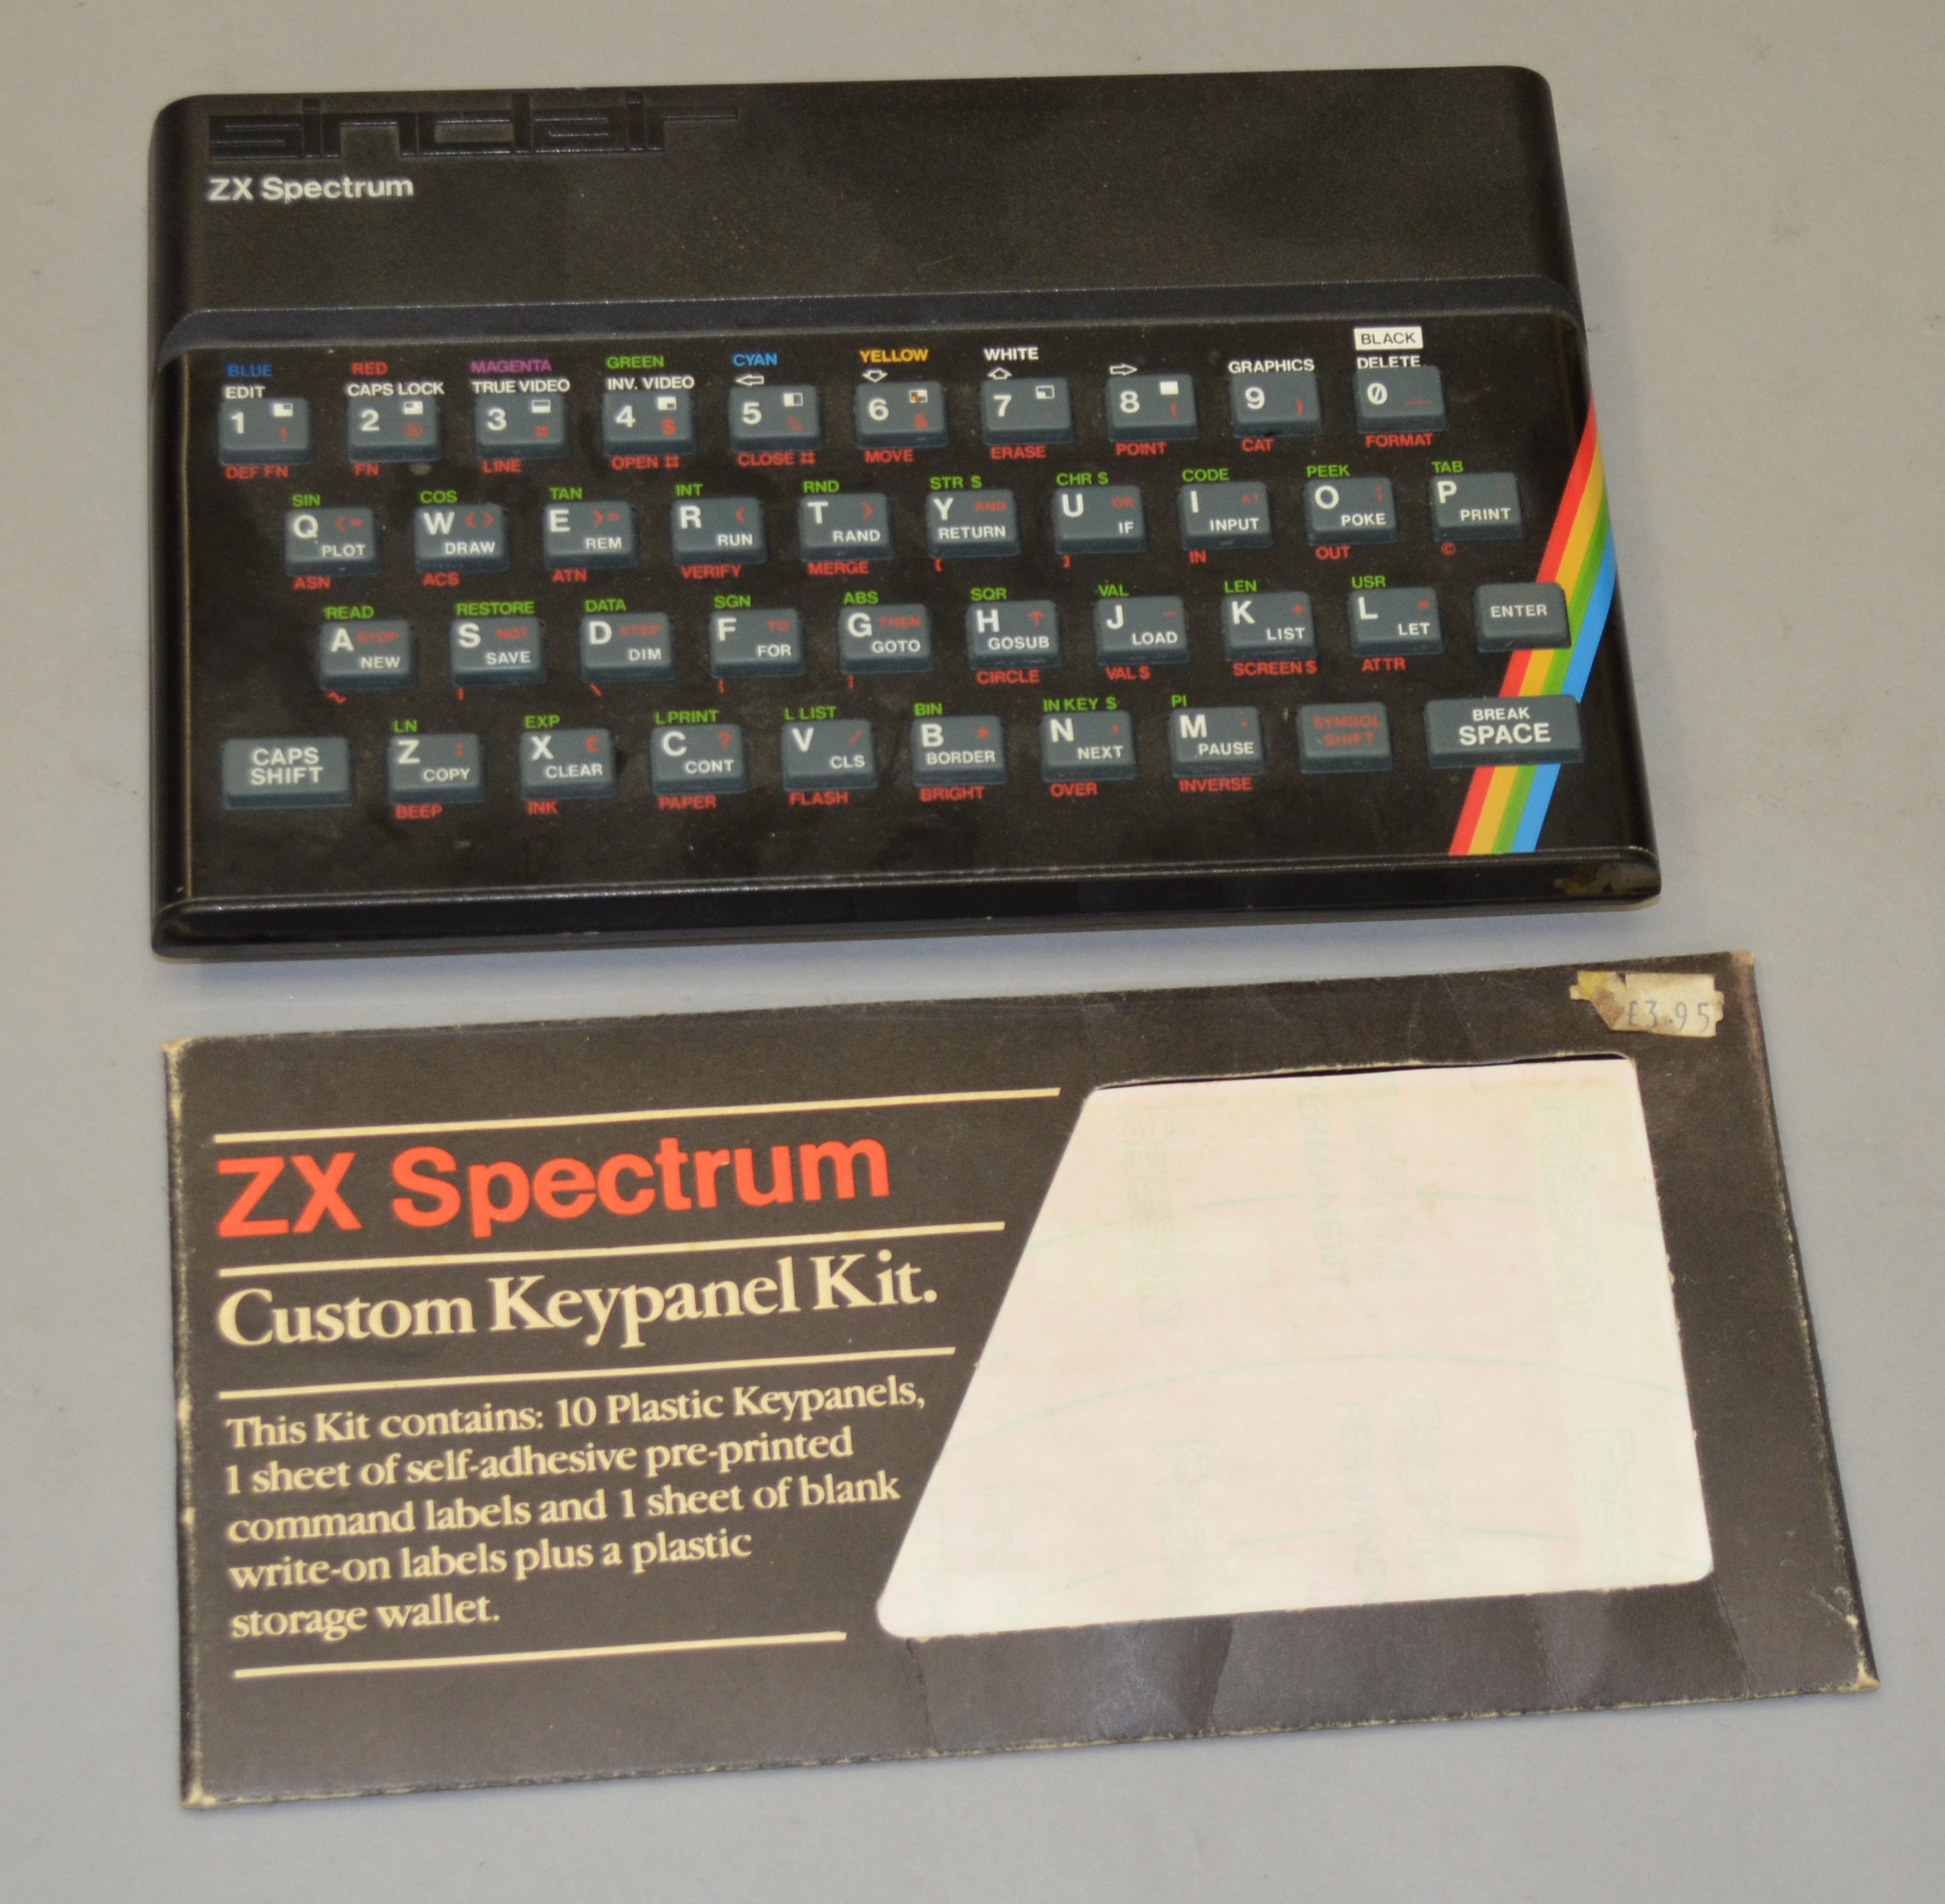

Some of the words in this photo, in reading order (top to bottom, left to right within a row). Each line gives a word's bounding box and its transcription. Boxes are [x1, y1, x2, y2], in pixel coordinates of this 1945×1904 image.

[209, 178, 252, 200] ZX
[262, 176, 413, 202] Spectrum
[1360, 332, 1416, 345] BLACK
[733, 352, 778, 367] CYAN
[860, 348, 929, 363] YELLOW
[984, 347, 1039, 361] WHITE
[351, 361, 389, 375] RED
[470, 358, 551, 373] MAGENTA
[605, 355, 665, 370] GREEN
[1228, 358, 1315, 374] GRAPHICS
[1357, 355, 1420, 370] DELETE
[226, 364, 272, 377] BLUE
[347, 383, 394, 397] CAPS
[398, 382, 444, 396] LOCK
[472, 380, 516, 393] TRUE
[519, 379, 571, 393] VIDEO
[642, 376, 695, 389] VIDEO
[225, 386, 264, 399] EDIT
[1245, 386, 1265, 410] 9
[993, 394, 1012, 417] 7
[1120, 390, 1140, 413] 8
[615, 405, 636, 427] 4
[743, 402, 762, 425] 5
[868, 398, 889, 421] 6
[361, 409, 379, 432] 2
[487, 408, 506, 431] 3
[1241, 438, 1273, 453] CAT
[1365, 432, 1433, 448] FORMAT
[865, 448, 913, 463] MOVE
[990, 445, 1046, 460] ERASE
[1116, 441, 1166, 456] POINT
[224, 465, 260, 480] DEF
[263, 465, 289, 477] FN
[354, 463, 379, 475] FN
[482, 459, 521, 473] LINE
[1306, 464, 1349, 478] PEEK
[1432, 460, 1464, 473] TAB
[1181, 468, 1228, 482] CODE
[549, 487, 583, 499] TAN
[675, 483, 702, 496] INT
[803, 480, 840, 493] RND
[292, 494, 321, 506] SIN
[419, 489, 458, 504] COS
[549, 509, 570, 532] E
[680, 506, 701, 528] R
[1341, 513, 1386, 527] POKE
[1460, 508, 1511, 521] PRINT
[293, 514, 318, 539] Q
[423, 512, 454, 535] W
[1118, 521, 1133, 534] IF
[1209, 518, 1260, 531] INPUT
[833, 530, 881, 542] RAND
[938, 525, 1006, 539] RETURN
[585, 537, 621, 549] REM
[717, 534, 752, 547] RUN
[321, 544, 365, 557] PLOT
[445, 542, 495, 555] DRAW
[1315, 545, 1350, 561] OUT
[1189, 550, 1207, 563] IN
[552, 569, 587, 582] ATN
[681, 564, 742, 579] VERIFY
[807, 561, 868, 575] MERGE
[293, 575, 331, 590] ASN
[422, 572, 461, 587] ACS
[1224, 580, 1257, 593] LEN
[1351, 575, 1386, 590] USR
[843, 590, 879, 604] ABS
[970, 587, 1008, 602] SQR
[1098, 584, 1129, 597] VAL
[456, 600, 534, 616] RESTORE
[585, 598, 627, 613] DATA
[714, 594, 752, 609] SGN
[324, 605, 374, 620] READ
[1490, 604, 1547, 618] ENTER
[848, 612, 872, 637] G
[976, 609, 999, 633] H
[589, 621, 611, 645] D
[1266, 627, 1305, 641] LIST
[1398, 622, 1430, 636] LET
[988, 636, 1049, 650] GOSUB
[1132, 631, 1178, 645] LOAD
[757, 644, 791, 657] FOR
[871, 639, 921, 654] GOTO
[486, 651, 530, 665] SAVE
[628, 648, 661, 661] DIM
[360, 657, 400, 669] NEW
[1362, 657, 1406, 671] ATTR
[976, 669, 1039, 685] CIRCLE
[1171, 695, 1188, 707] PI
[914, 702, 943, 716] BIN
[1473, 707, 1530, 721] BREAK
[393, 719, 418, 733] LN
[524, 714, 560, 728] EXP
[1180, 714, 1207, 738] M
[922, 724, 944, 747] B
[1459, 723, 1551, 746] SPACE
[661, 731, 687, 757] C
[1198, 741, 1254, 756] PAUSE
[252, 747, 319, 766] CAPS
[926, 750, 995, 765] BORDER
[1077, 745, 1123, 759] NEXT
[685, 759, 733, 774] CONT
[829, 755, 865, 769] CLS
[250, 766, 323, 786] SHIFT
[422, 768, 470, 782] COPY
[545, 763, 602, 779] CLEAR
[1049, 781, 1098, 798] OVER
[1179, 776, 1251, 792] INVERSE
[788, 791, 849, 806] FLASH
[920, 786, 984, 802] BRIGHT
[527, 801, 558, 814] INK
[658, 795, 717, 810] PAPER
[395, 804, 443, 819] BEEP
[218, 1152, 361, 1238] ZX
[391, 1137, 889, 1238] Spectrum
[218, 1288, 475, 1345] Custom
[489, 1257, 800, 1348] Keypanel
[810, 1250, 937, 1310] Kit.
[226, 1416, 306, 1448] This
[316, 1412, 370, 1442] Kit
[379, 1403, 543, 1439] contains:
[557, 1398, 597, 1427] 10
[607, 1390, 723, 1424] Plastic
[733, 1375, 925, 1422] Keypanels,
[227, 1465, 240, 1494] 1
[252, 1461, 350, 1492] sheet
[360, 1453, 401, 1485] of
[406, 1443, 637, 1483] self-adhesive
[646, 1426, 853, 1477] pre-printed
[227, 1501, 415, 1543] command
[426, 1495, 531, 1530] labels
[540, 1489, 607, 1523] and
[622, 1489, 635, 1518] 1
[647, 1485, 743, 1516] sheet
[753, 1477, 792, 1508] of
[800, 1470, 900, 1506] blank
[229, 1556, 391, 1588] write-on
[401, 1543, 507, 1578] labels
[515, 1539, 594, 1581] plus
[602, 1543, 622, 1566] a
[633, 1529, 751, 1574] plastic
[231, 1608, 367, 1642] storage
[377, 1593, 499, 1628] wallet.
